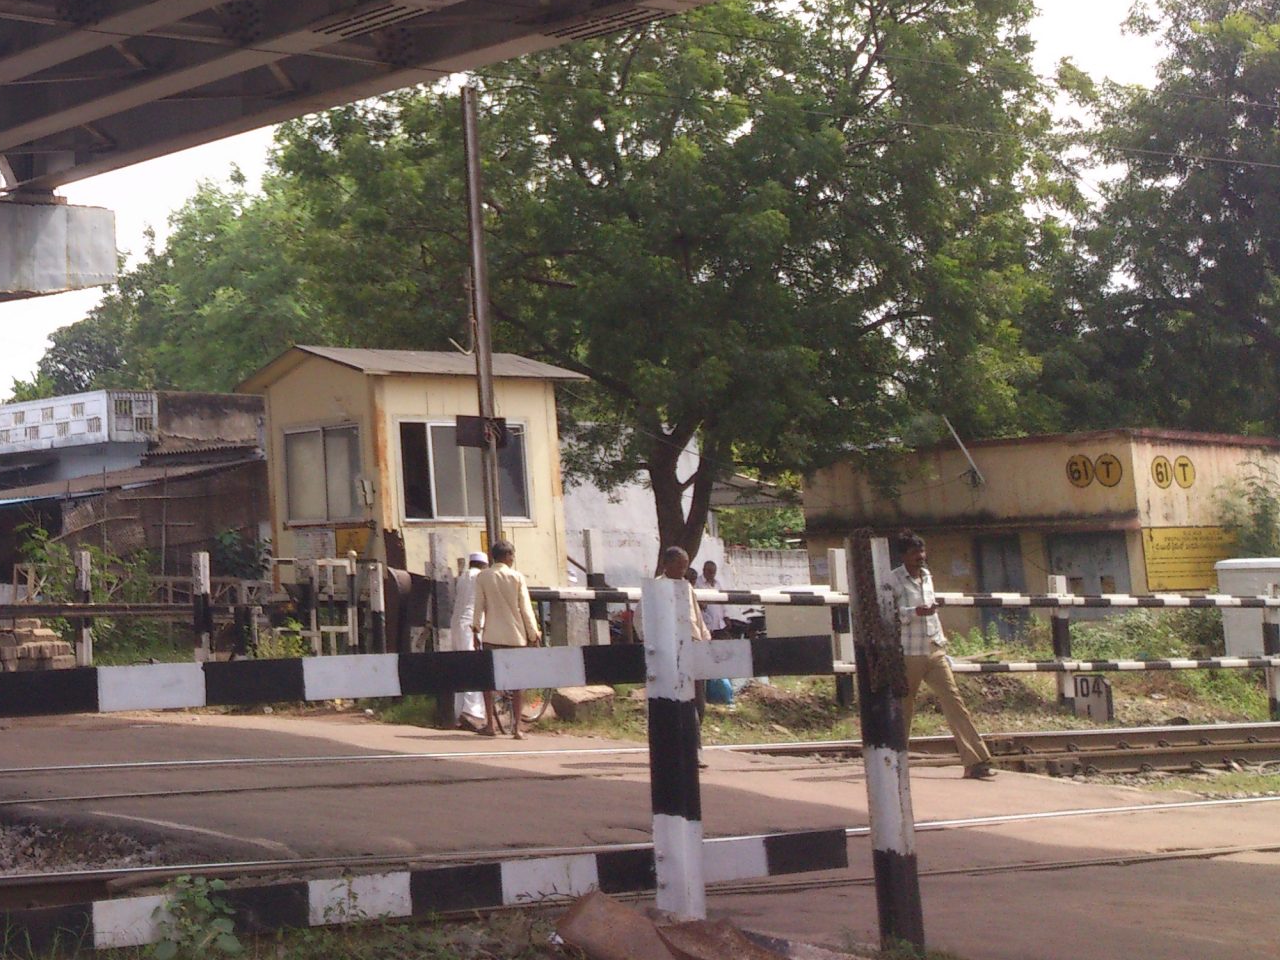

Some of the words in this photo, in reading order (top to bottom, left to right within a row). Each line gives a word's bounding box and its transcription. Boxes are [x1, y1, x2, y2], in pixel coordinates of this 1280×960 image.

[1070, 461, 1089, 481] 61
[1102, 461, 1113, 479] T
[1155, 462, 1169, 483] 61
[1178, 463, 1188, 481] T
[1074, 677, 1103, 698] 104
